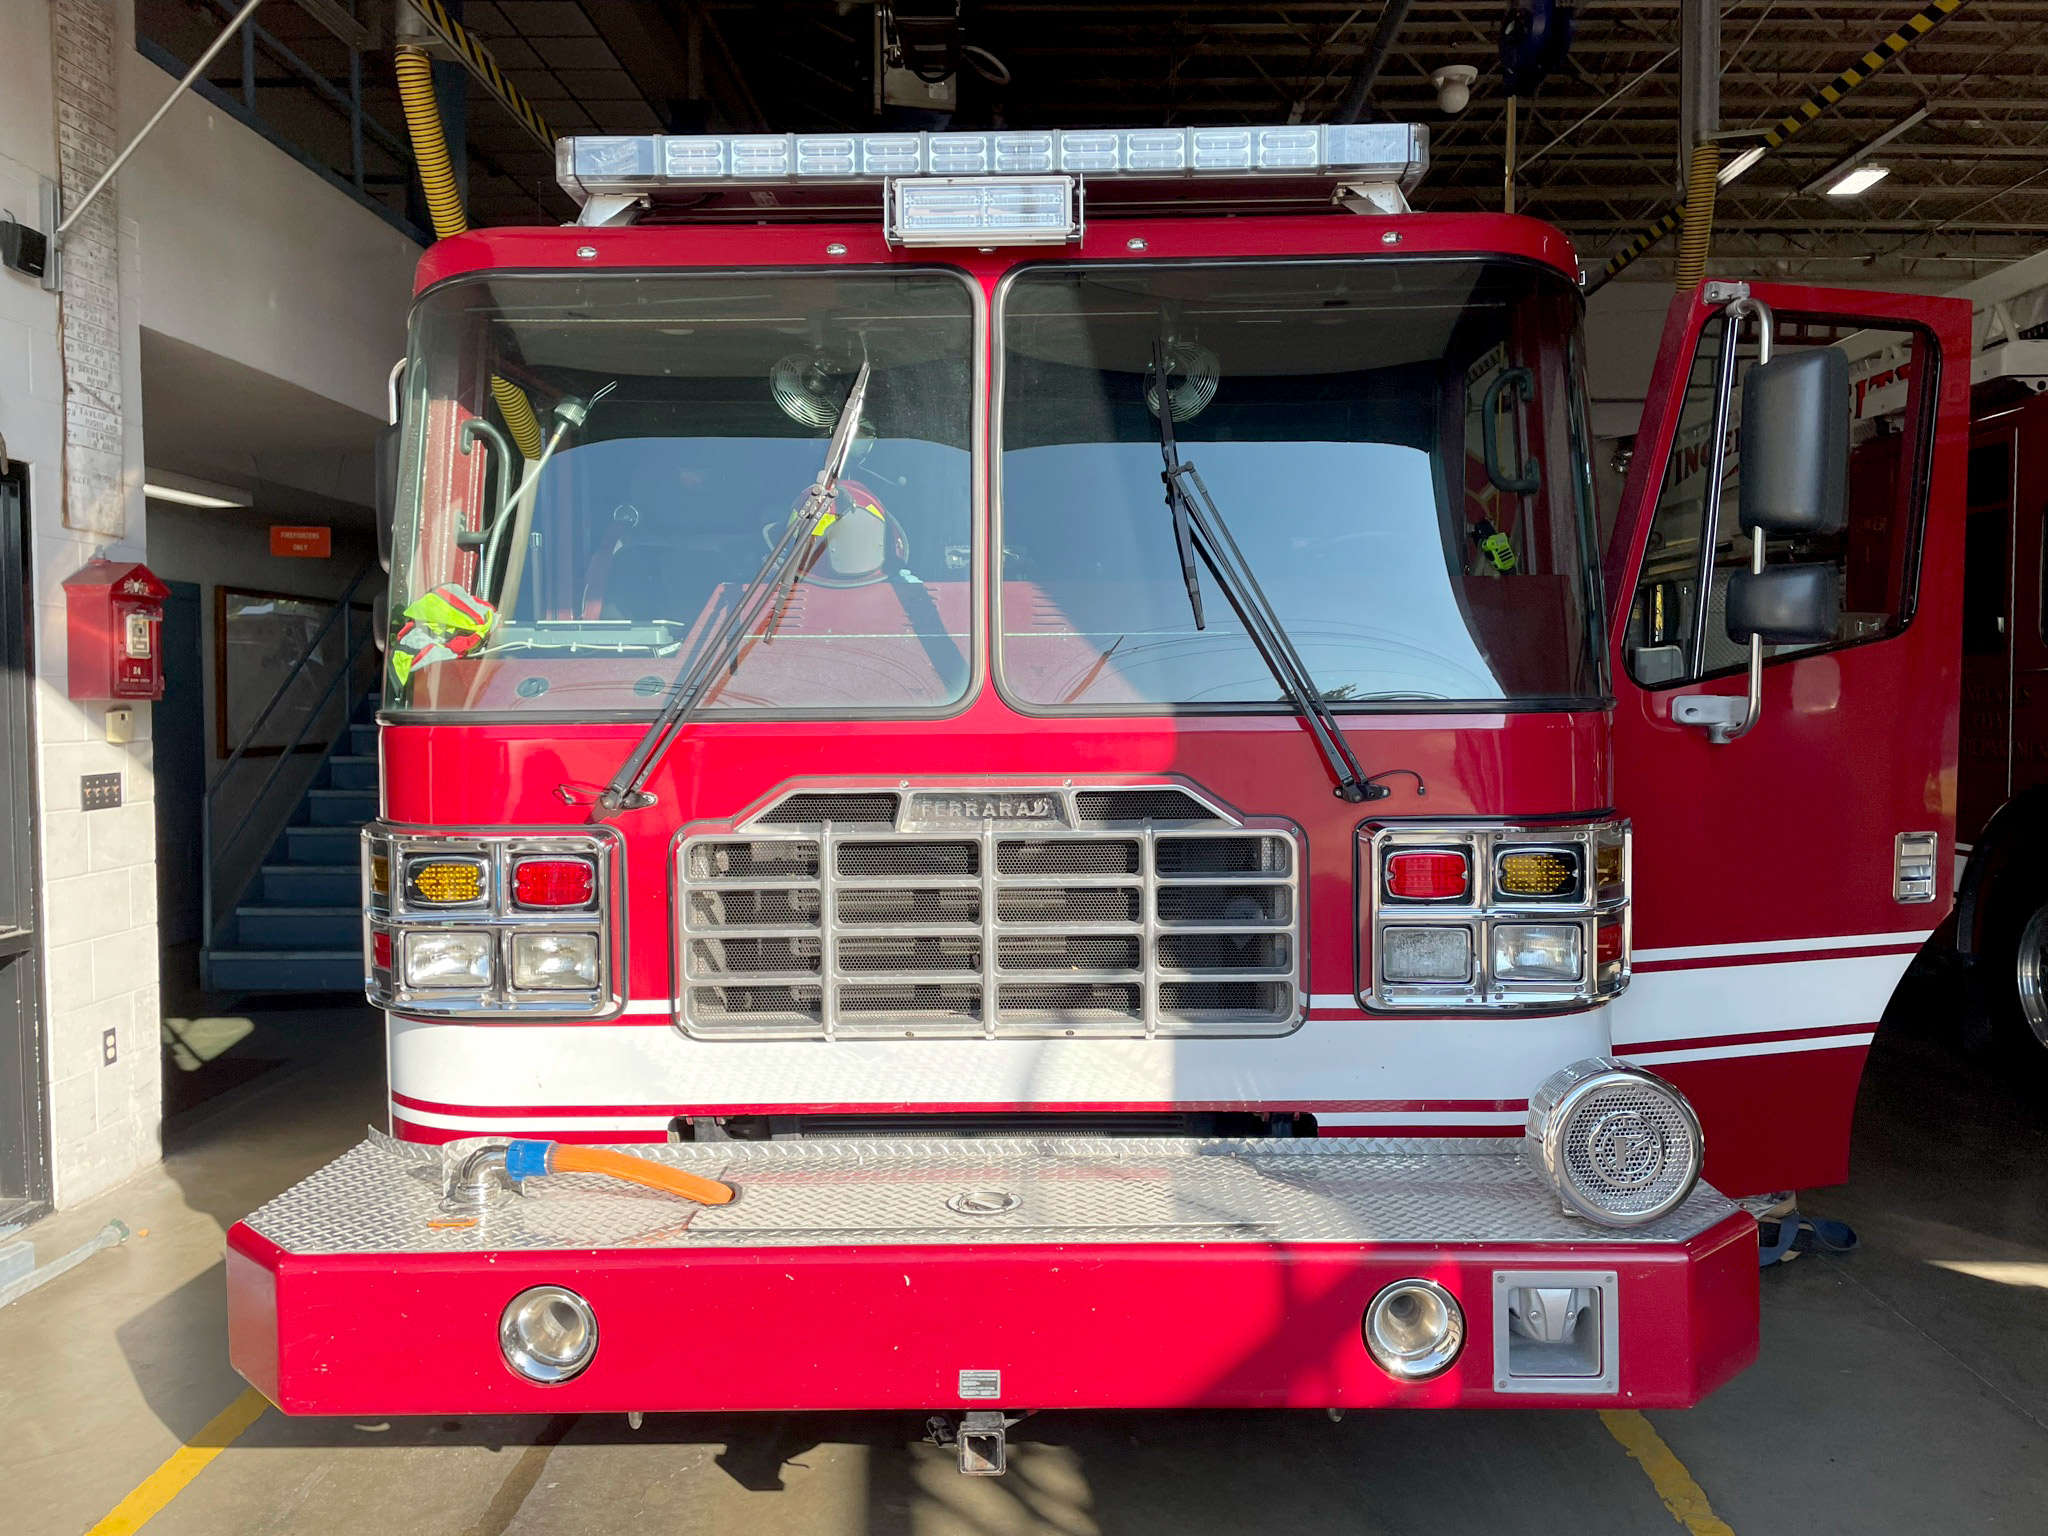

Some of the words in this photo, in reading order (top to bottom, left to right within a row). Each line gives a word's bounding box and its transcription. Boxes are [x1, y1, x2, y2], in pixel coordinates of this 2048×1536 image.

[79, 407, 107, 420] TAYLOR
[85, 418, 118, 433] HIGHLAND
[280, 531, 320, 540] FIREFIGHTERS
[292, 543, 308, 552] ONLY
[132, 666, 142, 675] 24
[921, 799, 1030, 818] FERRARA
